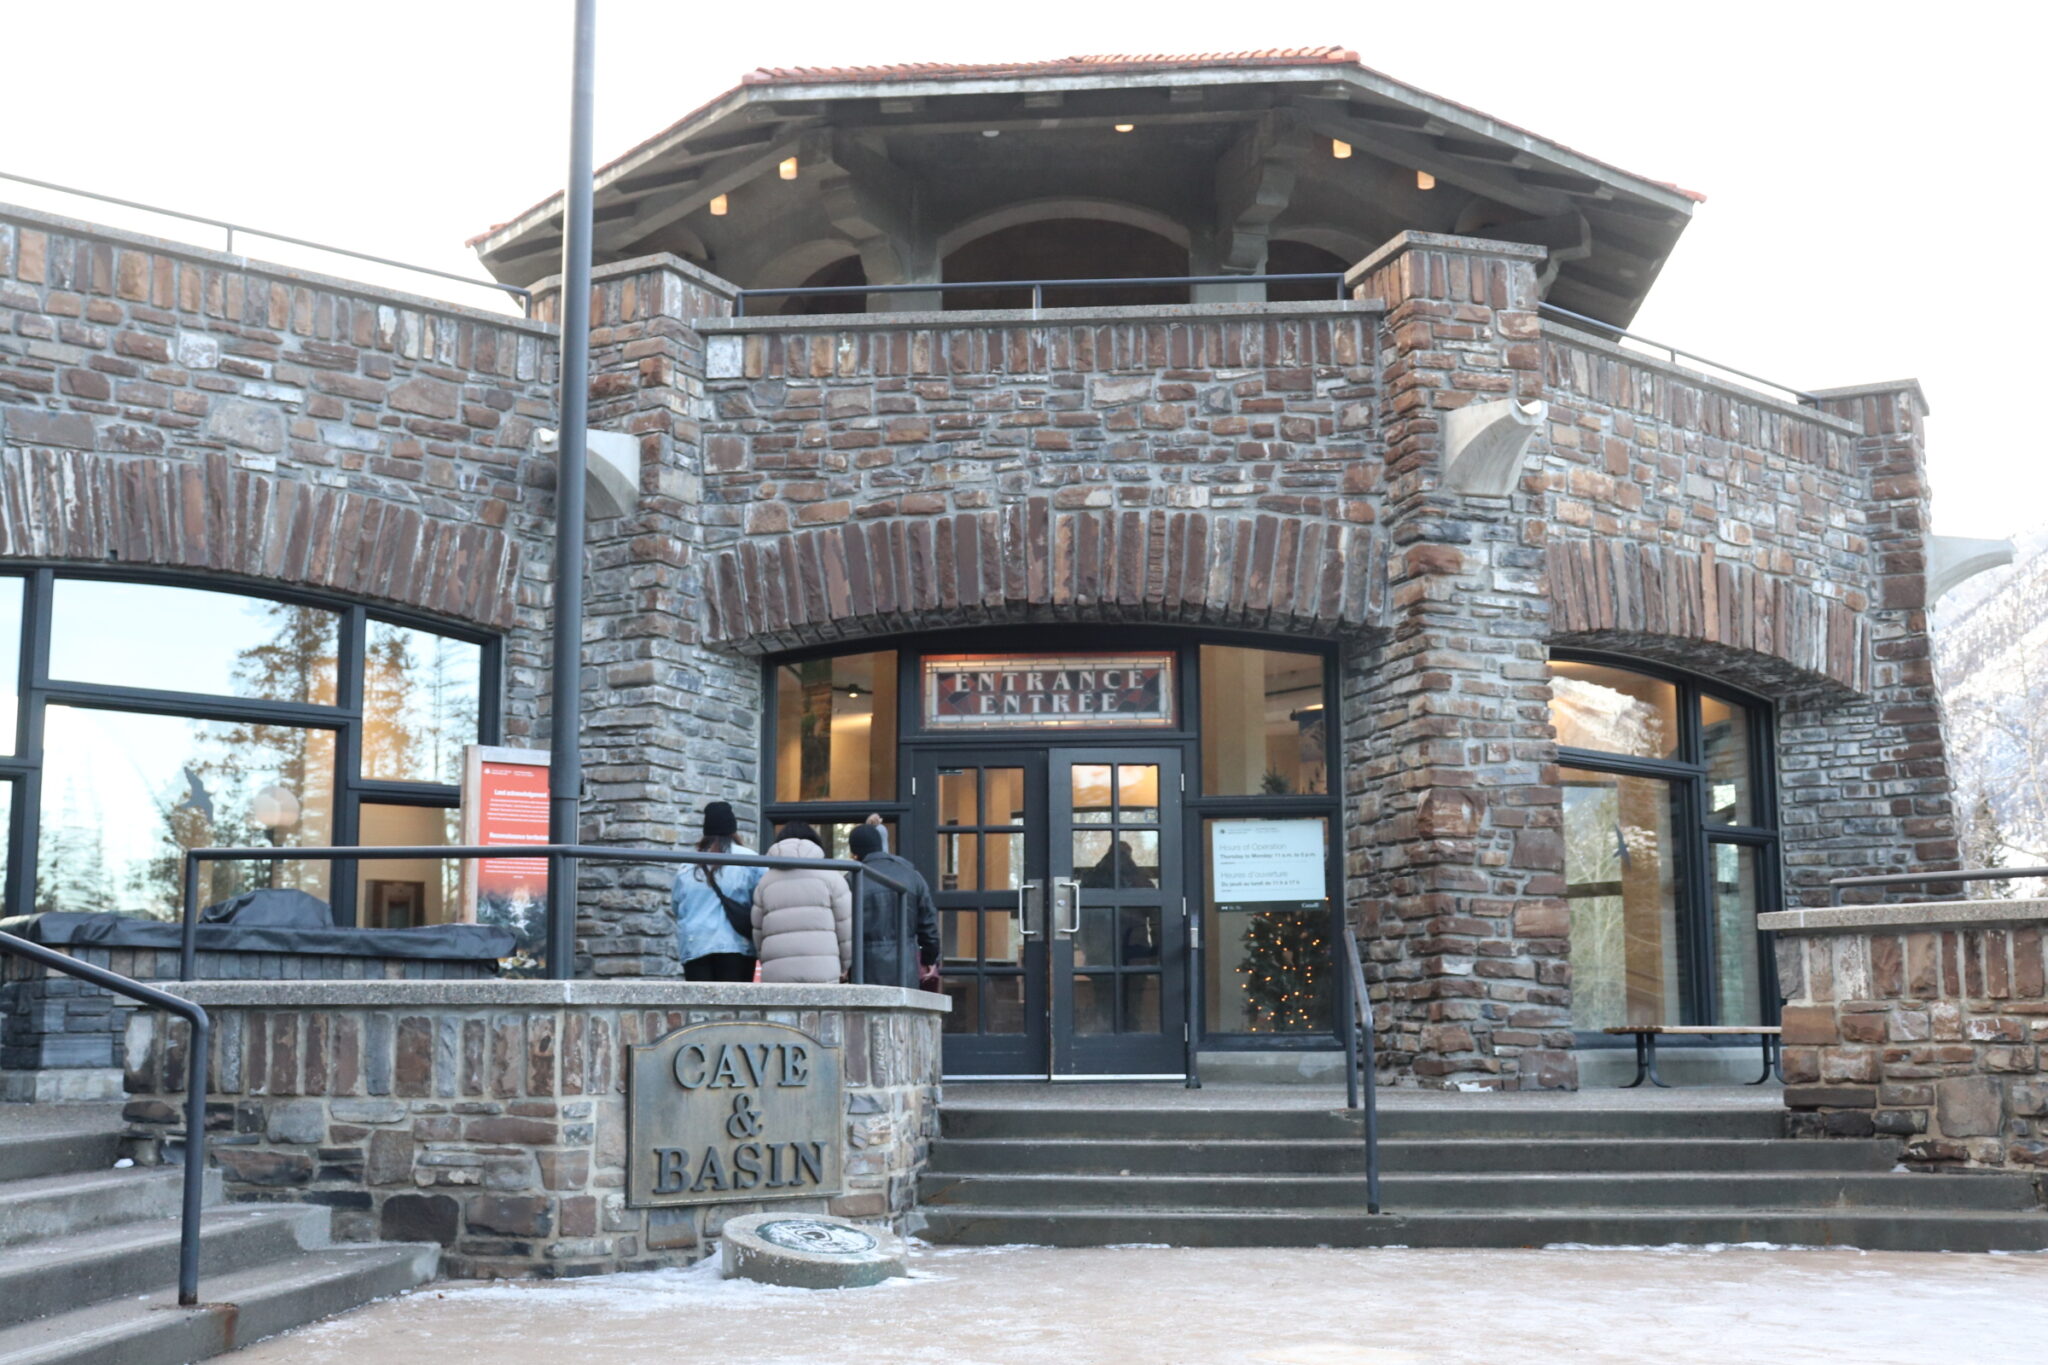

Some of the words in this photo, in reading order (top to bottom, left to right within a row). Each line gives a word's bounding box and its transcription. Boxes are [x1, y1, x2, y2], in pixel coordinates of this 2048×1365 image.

[954, 670, 1145, 693] ENTRANCE
[979, 690, 1120, 714] ENTRÉE
[1251, 842, 1287, 851] Operation
[673, 1043, 808, 1089] CAVE
[726, 1092, 763, 1139] &
[653, 1141, 827, 1195] BASIN
